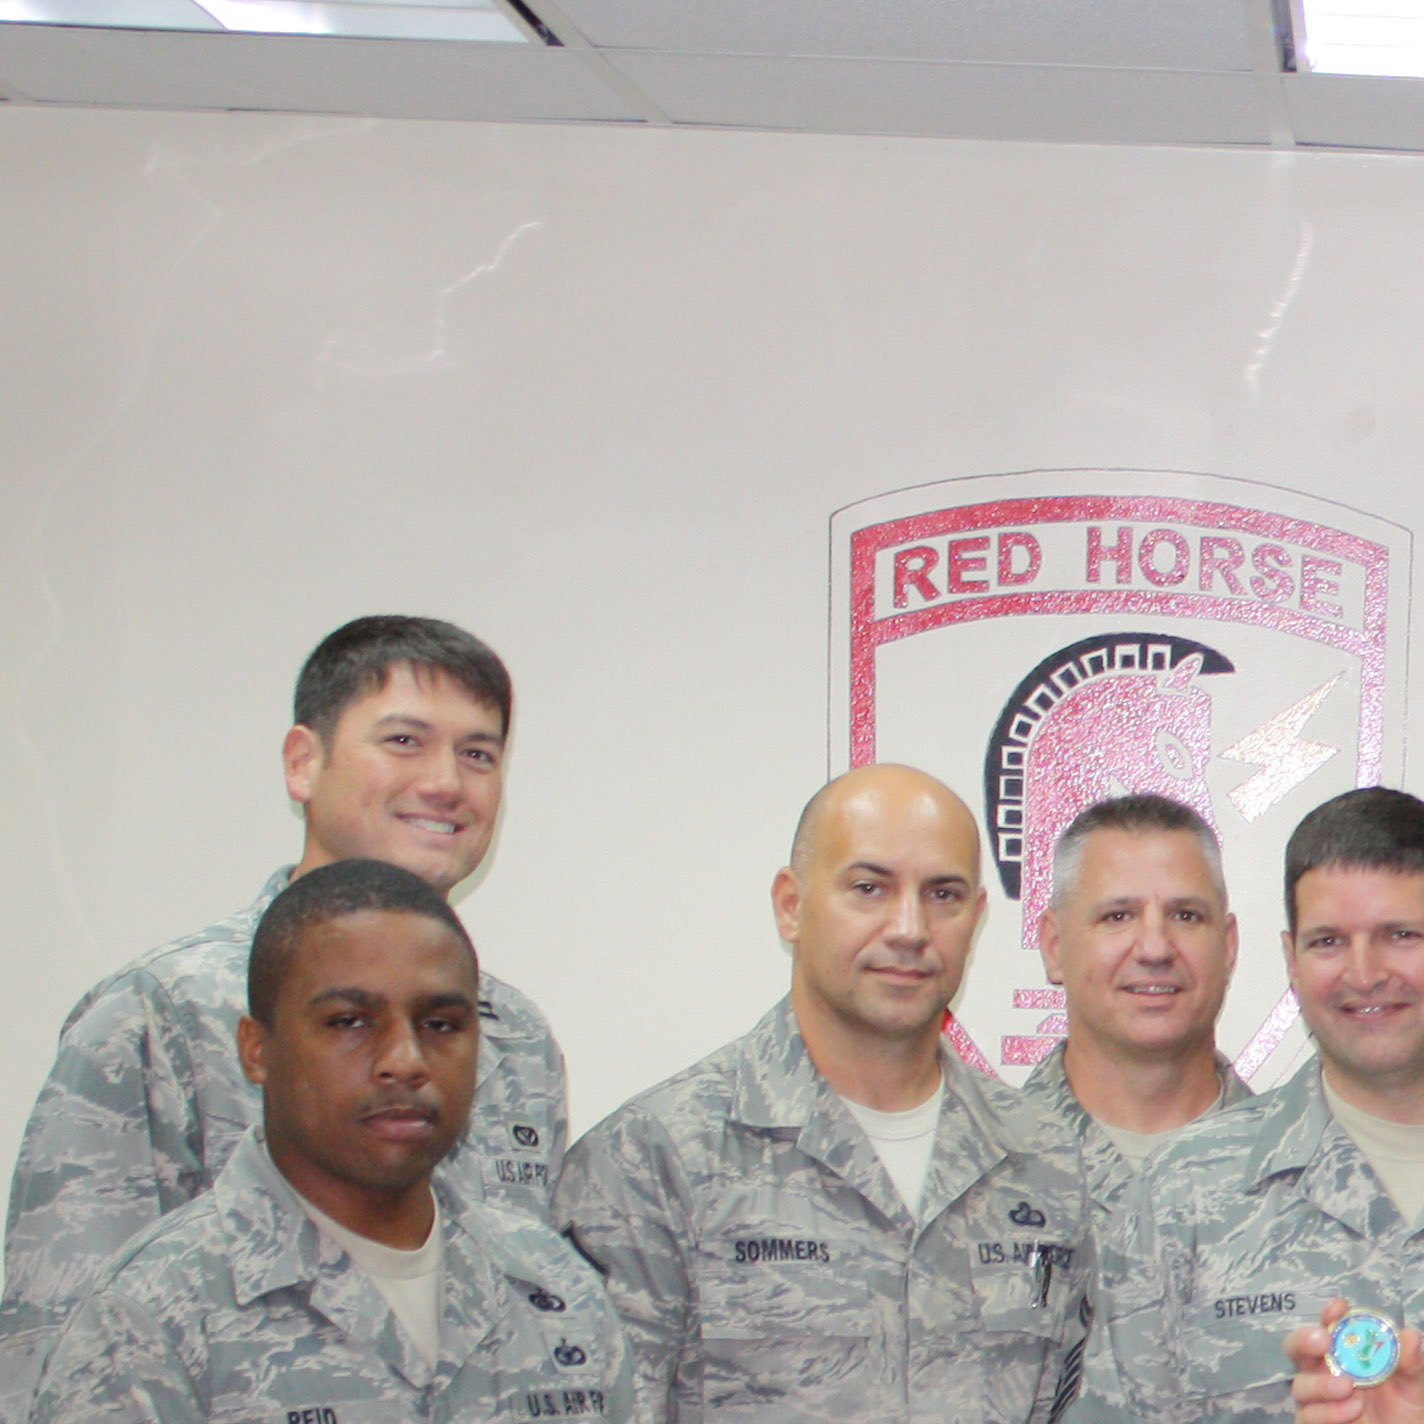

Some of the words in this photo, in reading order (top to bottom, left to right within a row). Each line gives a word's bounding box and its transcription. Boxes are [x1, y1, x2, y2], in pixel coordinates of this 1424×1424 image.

[893, 530, 1042, 607] RED
[1086, 526, 1344, 618] HORSE
[735, 1239, 830, 1263] SOMMERS
[1214, 1292, 1296, 1319] STEVENS
